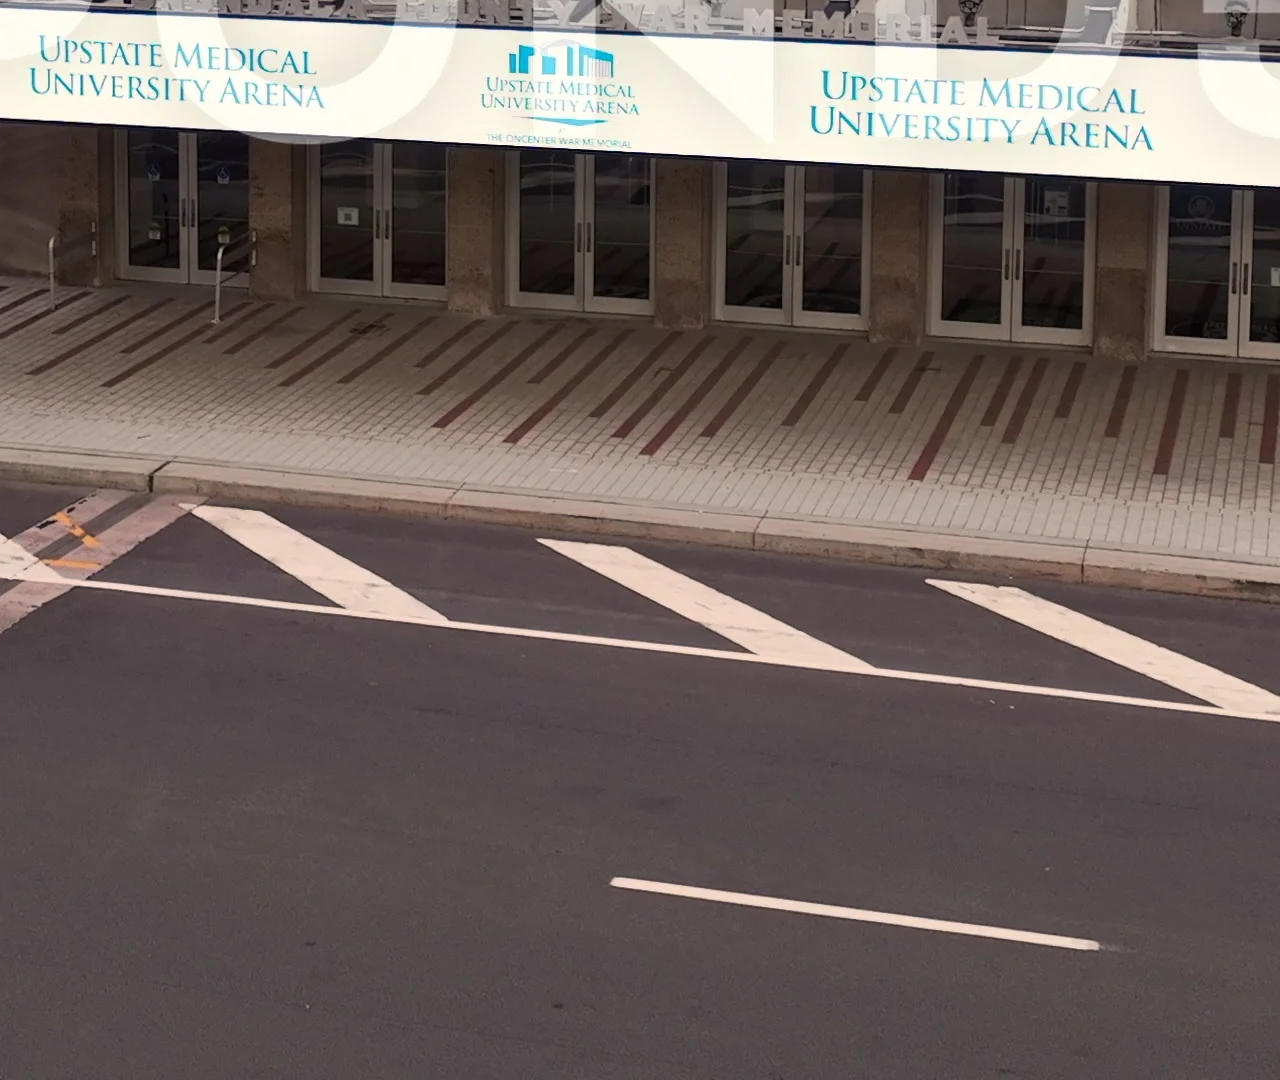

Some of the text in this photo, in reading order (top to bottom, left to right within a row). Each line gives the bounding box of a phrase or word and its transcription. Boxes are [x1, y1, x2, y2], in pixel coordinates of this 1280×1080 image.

[609, 1, 713, 35] WAR
[742, 7, 1000, 45] MEMORIAL
[38, 33, 318, 76] UPSTATE MEDICAL
[29, 66, 326, 109] UNIVERSITY ARENA
[480, 93, 640, 116] UNIVERSITY ARENA
[486, 76, 636, 99] UPSTATE MEDICAL
[820, 69, 1146, 116] UPSTATE MEDICAL
[486, 133, 634, 150] THE ONCENTER WAR MEMORIAL
[809, 104, 1156, 152] UNIVERSITY ARENA
